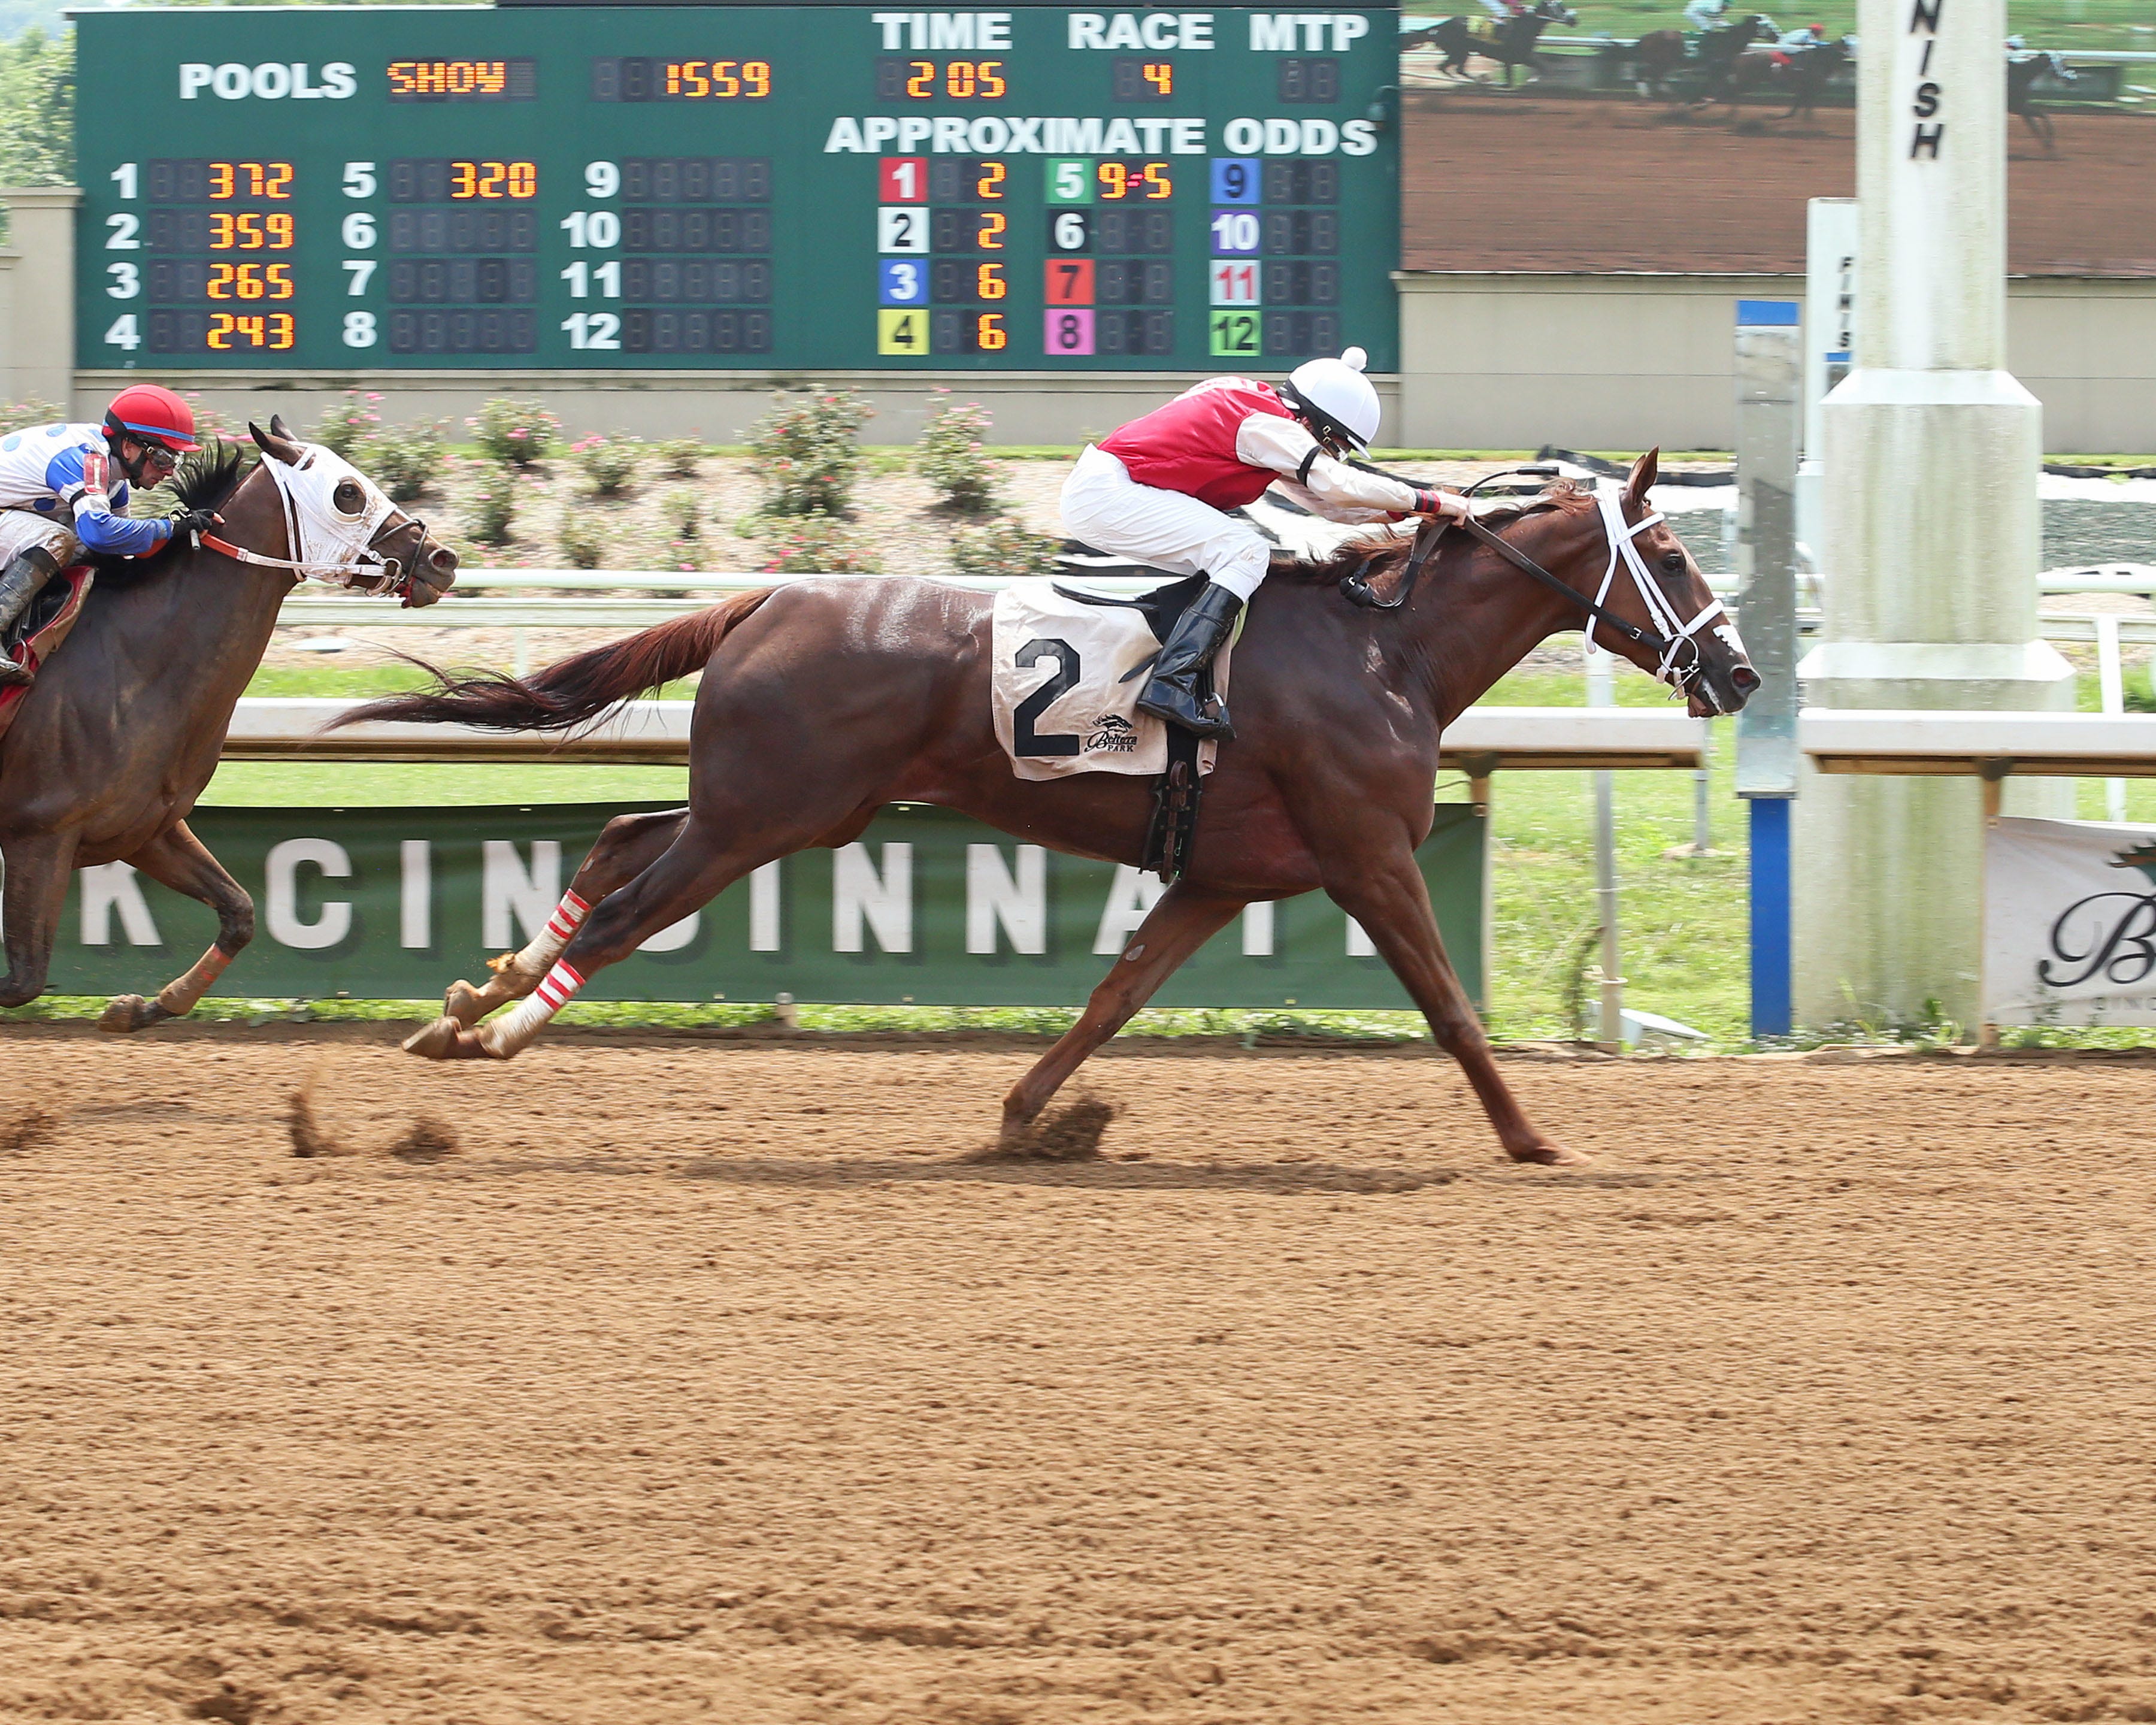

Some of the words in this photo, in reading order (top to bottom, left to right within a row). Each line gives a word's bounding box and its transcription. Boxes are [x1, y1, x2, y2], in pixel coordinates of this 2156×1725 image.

[871, 13, 1013, 50] TIME
[1068, 13, 1215, 50] RACE
[1249, 14, 1369, 52] MTP
[179, 62, 358, 100] POOLS
[387, 61, 506, 93] SHOW
[666, 61, 771, 97] 1559
[1143, 63, 1172, 95] 4
[823, 117, 1207, 154] APPROXIMATE
[1223, 117, 1377, 156] ODDS
[110, 162, 138, 199] 1
[208, 163, 294, 199] 372
[341, 162, 377, 198] 5
[450, 162, 537, 199] 320
[585, 161, 620, 198] 9
[892, 162, 916, 198] 1
[977, 162, 1006, 198] 2
[1055, 163, 1085, 199] 5
[1224, 164, 1246, 198] 9
[105, 213, 140, 250] 2
[208, 213, 294, 249] 359
[342, 213, 377, 249] 6
[560, 211, 620, 249] 10
[892, 213, 912, 247] 2
[977, 213, 1006, 249] 2
[1054, 213, 1085, 250] 6
[1212, 213, 1260, 250] 10
[105, 262, 141, 299] 3
[207, 264, 294, 299] 265
[342, 260, 377, 296] 7
[560, 261, 621, 298] 11
[889, 263, 919, 300] 3
[977, 263, 1007, 299] 6
[1057, 265, 1082, 299] 7
[1215, 265, 1255, 300] 11
[104, 314, 141, 350] 4
[207, 313, 295, 349] 243
[342, 311, 377, 347] 8
[560, 313, 620, 349] 12
[892, 314, 915, 349] 4
[977, 313, 1007, 350] 6
[1058, 314, 1081, 349] 8
[1211, 316, 1257, 351] 12
[1013, 638, 1080, 756] 2
